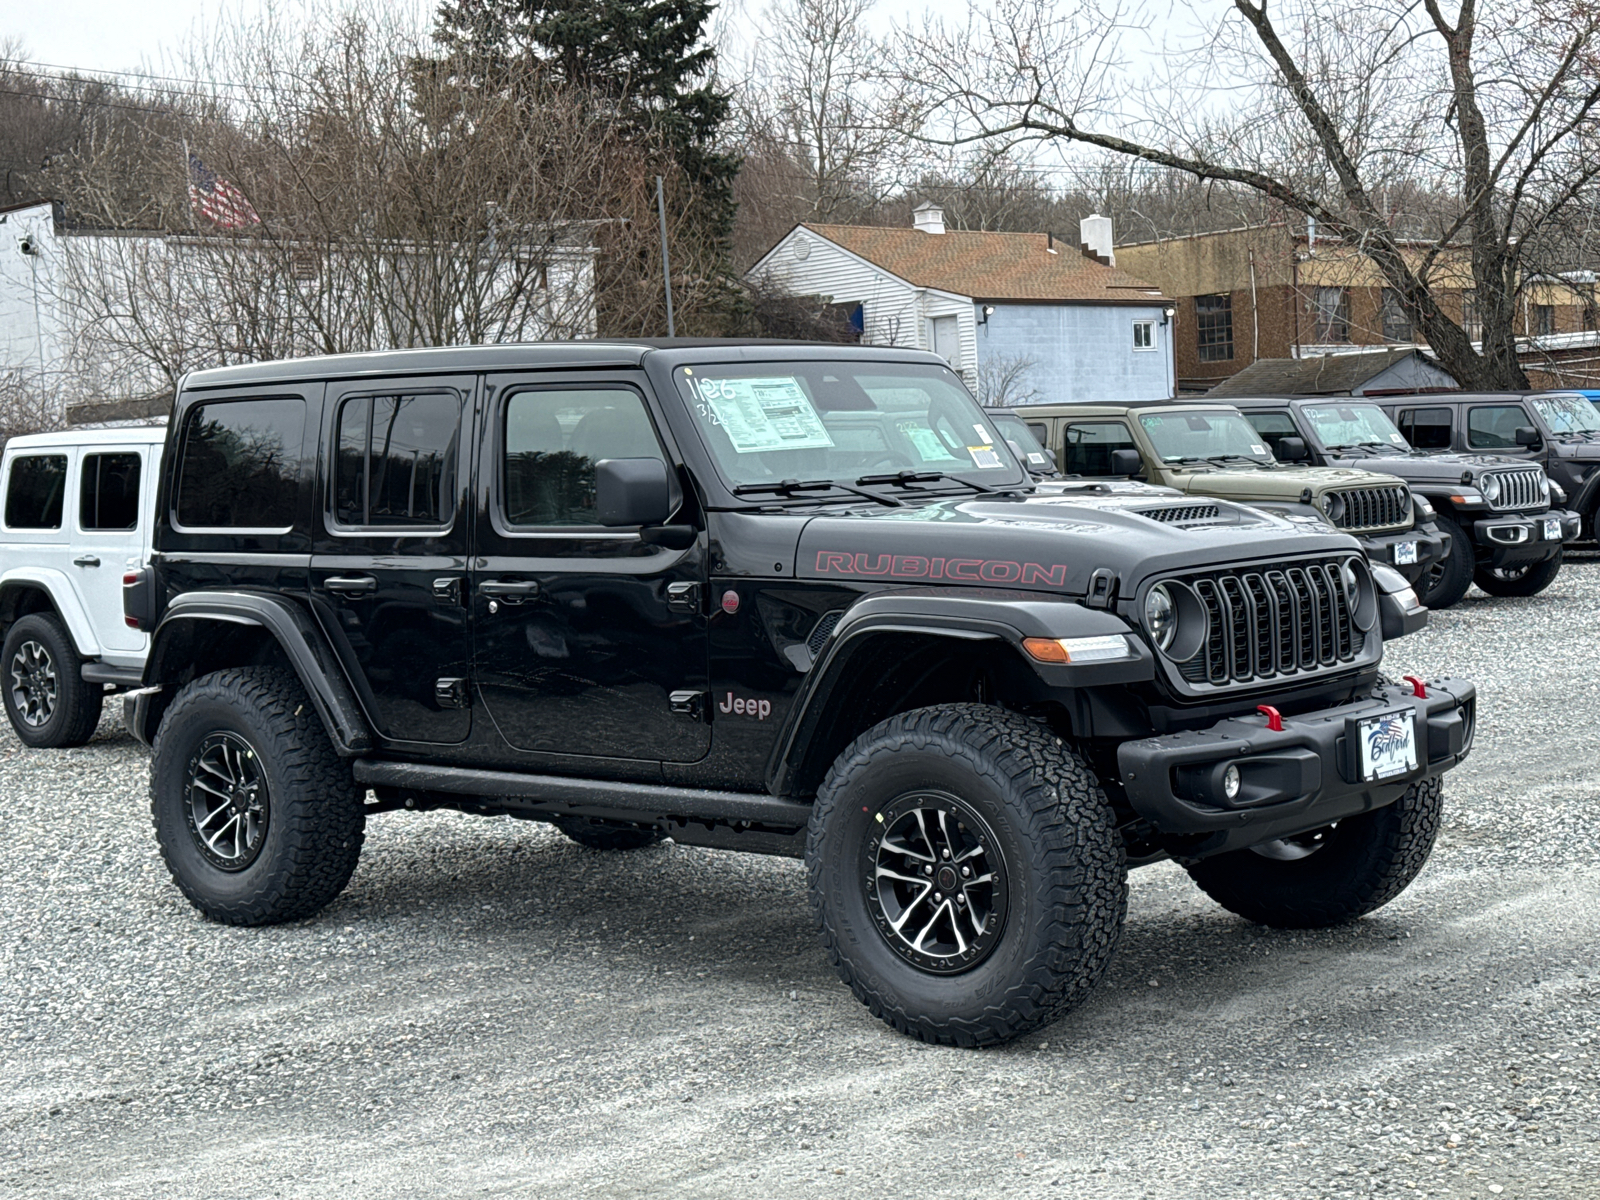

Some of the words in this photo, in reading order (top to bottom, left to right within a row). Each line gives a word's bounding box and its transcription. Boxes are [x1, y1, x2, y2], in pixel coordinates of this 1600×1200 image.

[685, 377, 737, 401] 1126
[696, 404, 729, 425] 3/26
[815, 550, 1067, 586] RUBICON
[719, 692, 771, 720] Jeep
[1369, 730, 1410, 761] Bedford
